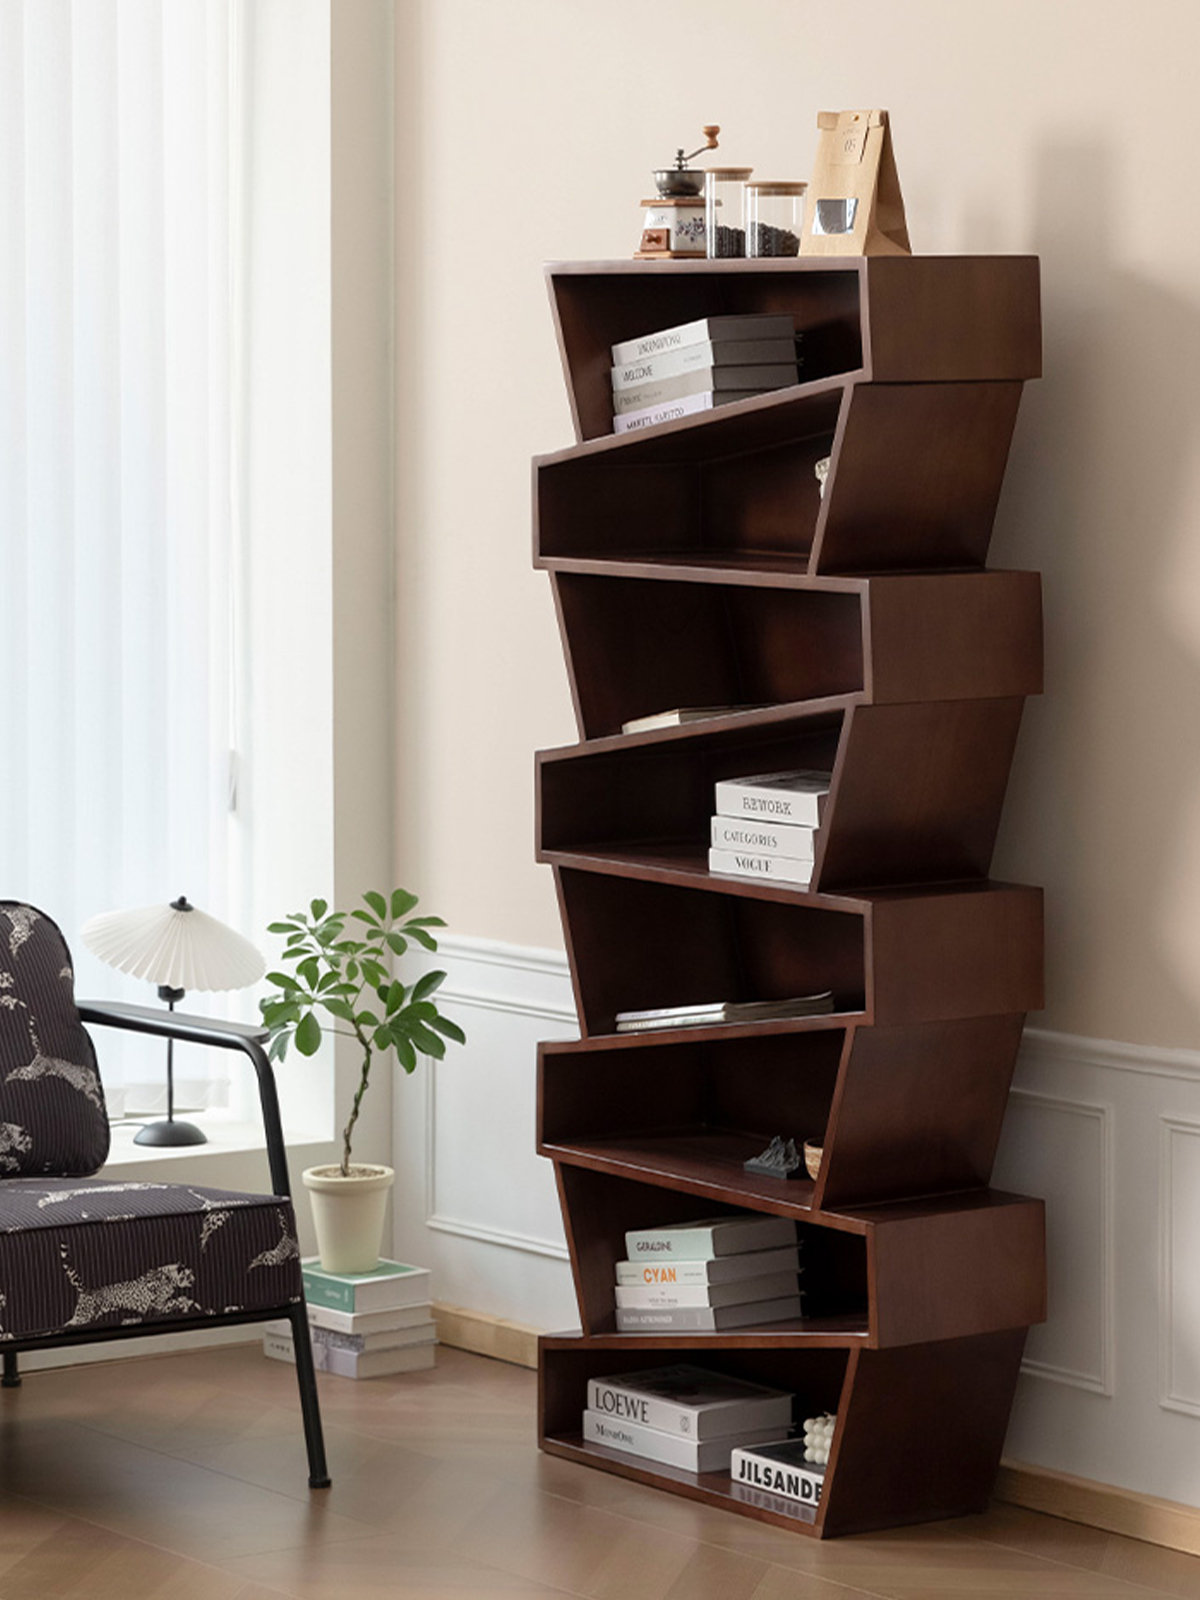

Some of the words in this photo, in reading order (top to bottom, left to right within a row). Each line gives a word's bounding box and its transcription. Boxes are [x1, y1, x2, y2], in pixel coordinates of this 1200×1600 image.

[742, 797, 792, 816] REWORK
[723, 830, 778, 848] CATEGORIES
[735, 856, 773, 873] VOGUE
[643, 1267, 677, 1284] CYAN
[595, 1387, 650, 1424] LOEWE
